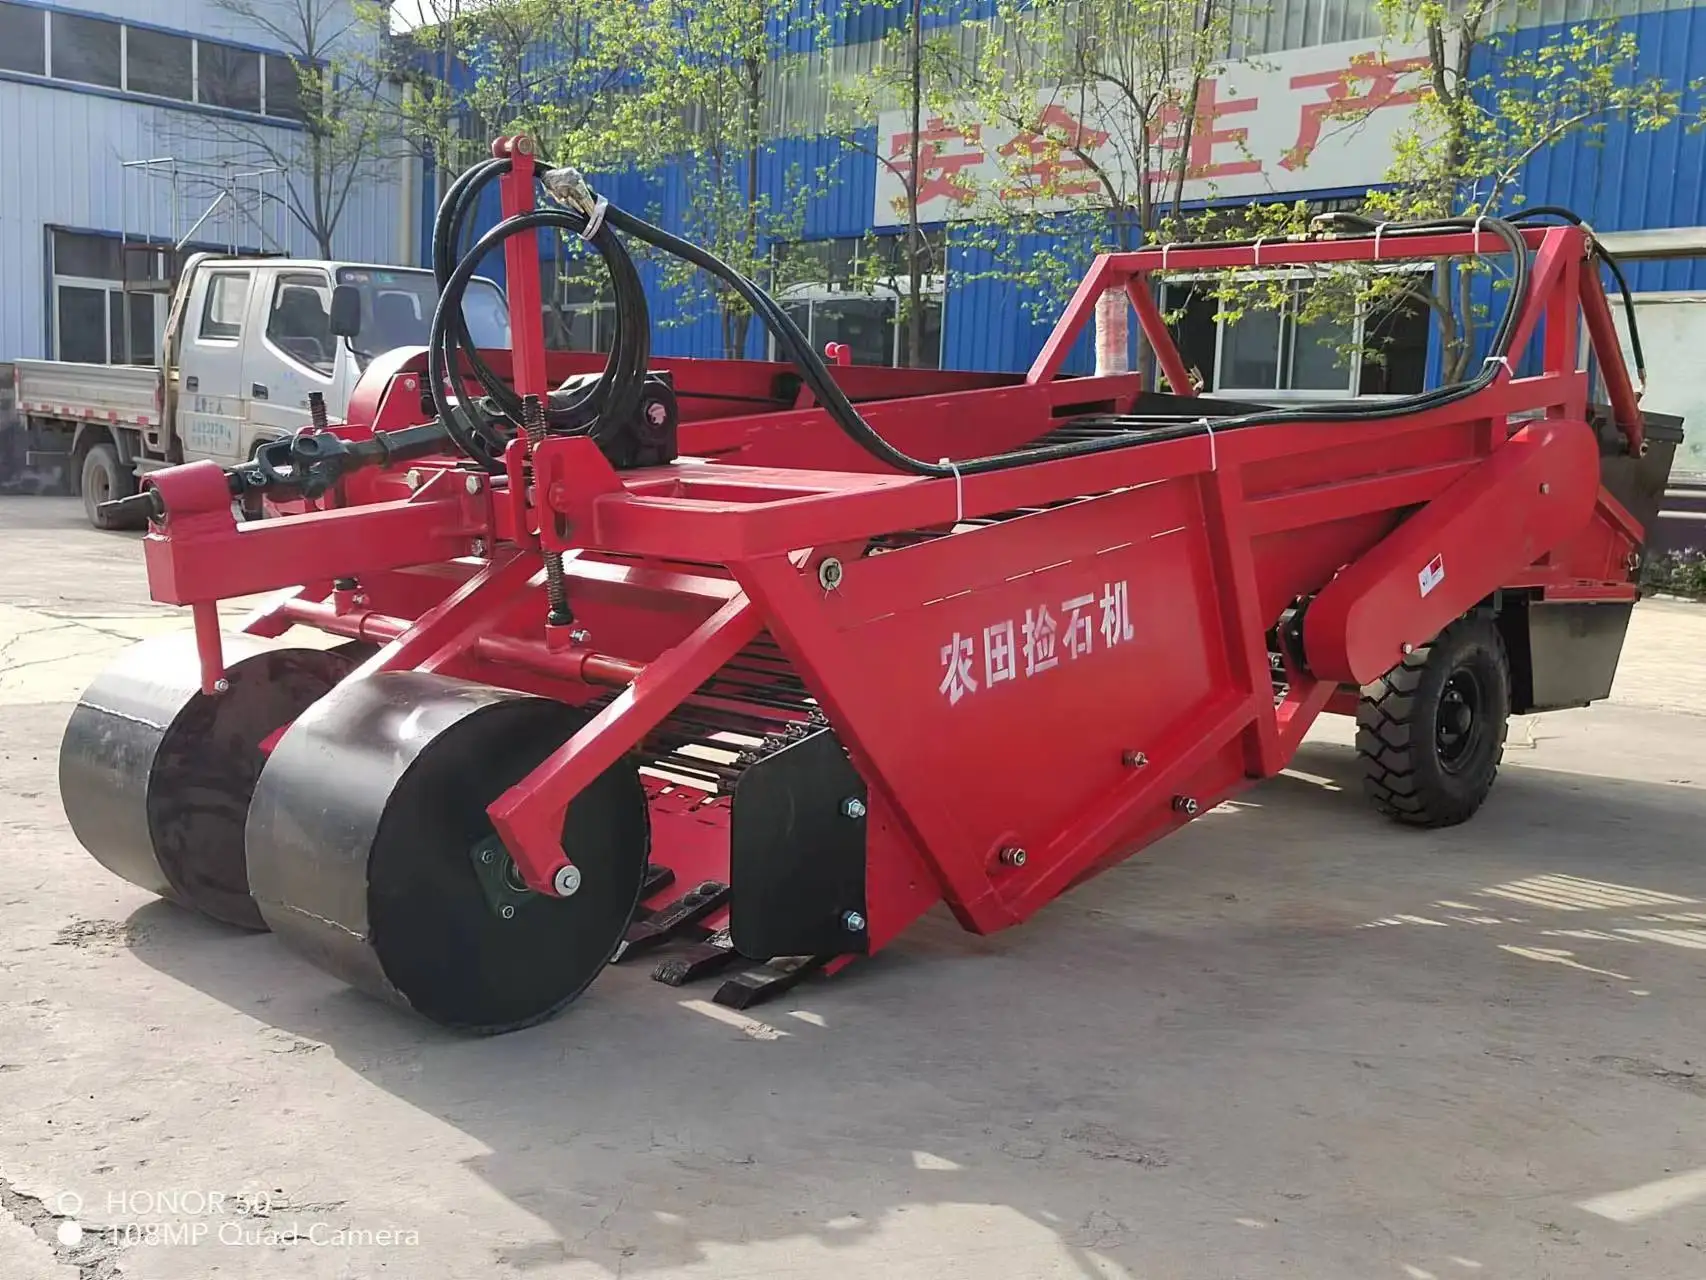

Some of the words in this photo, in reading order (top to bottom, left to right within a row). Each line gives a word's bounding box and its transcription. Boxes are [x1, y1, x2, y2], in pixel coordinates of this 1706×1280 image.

[886, 51, 1433, 208] 安全生产
[938, 580, 1135, 706] 农田捡石机
